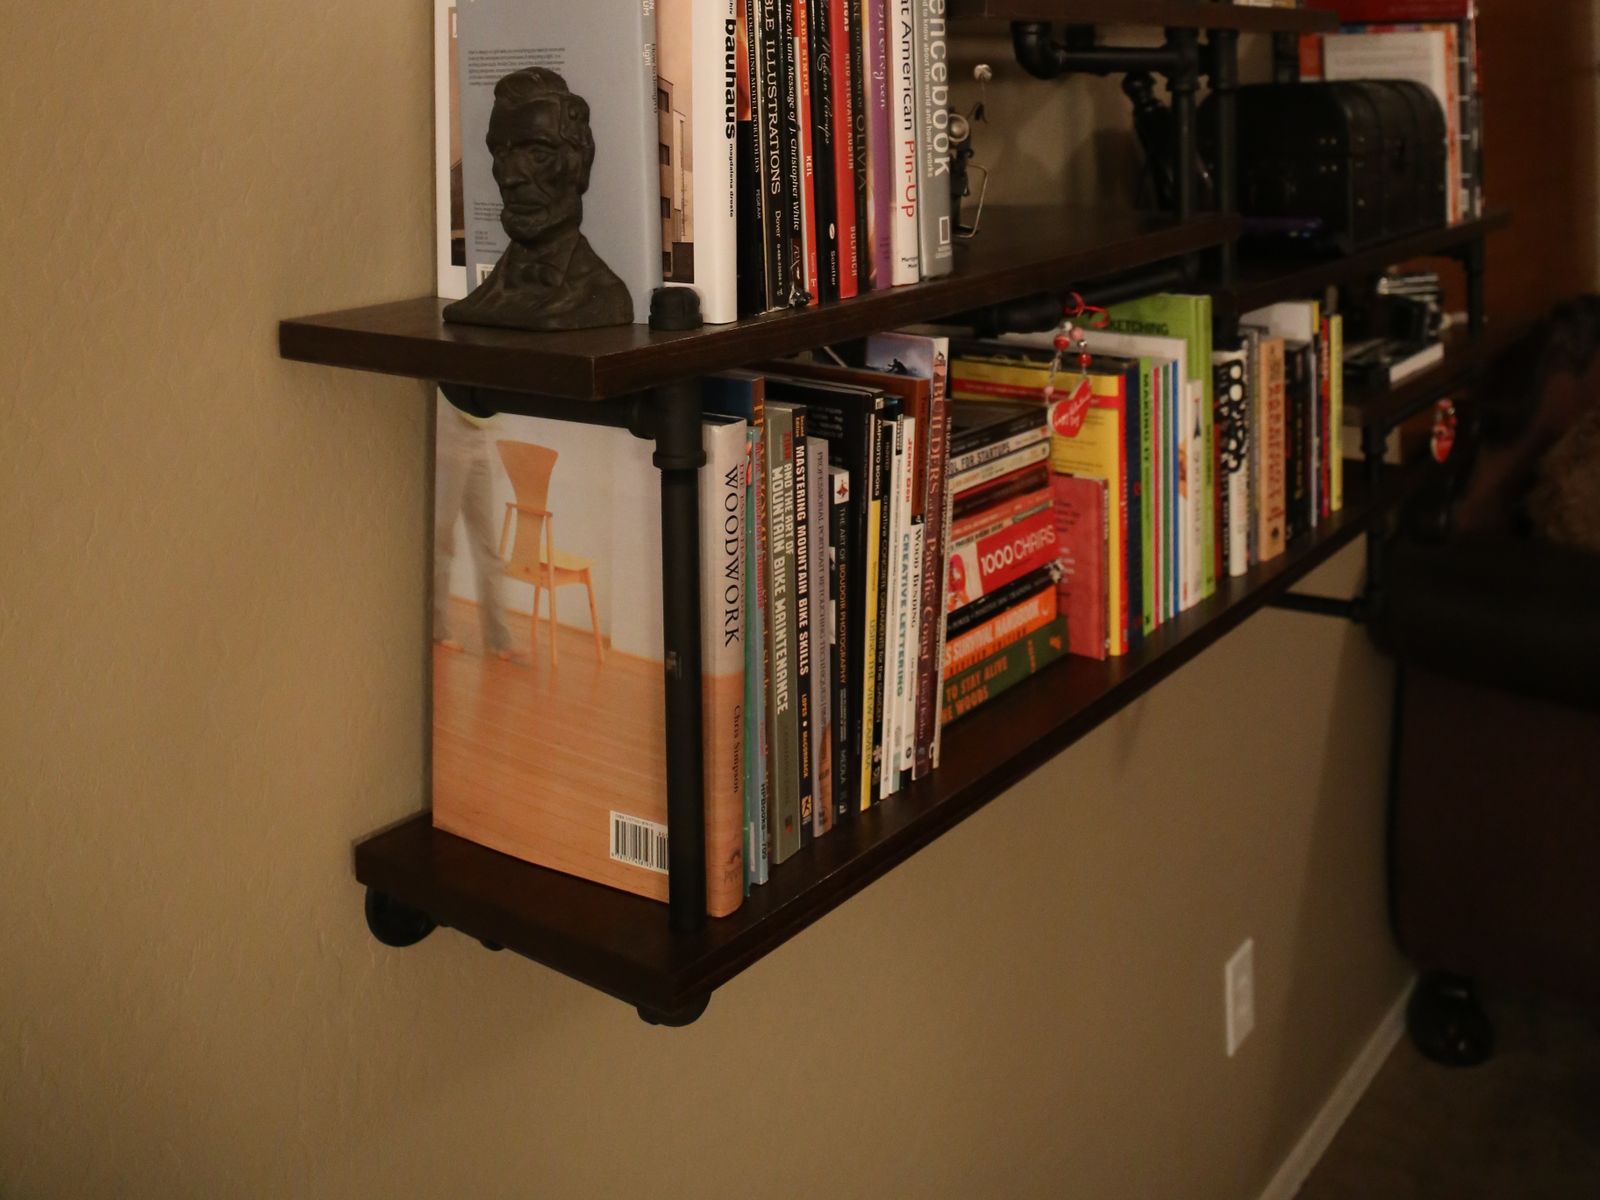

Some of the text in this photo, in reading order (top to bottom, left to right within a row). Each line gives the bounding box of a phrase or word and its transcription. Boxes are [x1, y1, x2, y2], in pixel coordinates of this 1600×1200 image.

[785, 2, 794, 23] The
[785, 24, 795, 42] Art
[799, 8, 807, 44] MADE
[921, 8, 930, 18] to
[921, 18, 930, 41] know
[642, 44, 652, 66] Light
[786, 42, 796, 63] and
[800, 48, 809, 97] SIMPLE
[901, 20, 915, 131] American
[922, 42, 931, 67] about
[922, 68, 931, 83] the
[725, 18, 737, 140] bauhaus
[787, 65, 798, 109] Message
[923, 83, 932, 107] world
[765, 40, 781, 195] ILLUSTRATIONS
[788, 110, 798, 122] of
[789, 127, 798, 135] J.
[923, 108, 932, 124] and
[924, 126, 932, 142] how
[789, 138, 801, 201] Christopher
[855, 113, 866, 192] OLIVIA
[924, 143, 932, 151] it
[925, 152, 933, 178] works
[902, 139, 918, 218] Pin-Up
[774, 210, 782, 238] Dover
[792, 201, 802, 232] White
[874, 418, 883, 496] AMPHOTO BOOKS
[929, 381, 945, 495] BUILDERS
[772, 466, 786, 554] MOUNTAIN
[784, 463, 794, 556] AND THE ART OF
[817, 451, 825, 525] PROFESSIONAL
[724, 464, 738, 648] WOODWORK
[795, 444, 809, 676] MASTERING MOUNTAIN BIKE SKILLS
[839, 552, 846, 562] OF
[924, 537, 937, 601] Pacific
[982, 546, 1013, 576] 1000
[1014, 525, 1056, 560] CHAIRS
[773, 557, 787, 594] BIKE
[911, 528, 922, 628] WOOD BENDING
[774, 597, 789, 716] MAINTENANCE
[839, 610, 847, 685] PHOTOGRAPHY
[920, 606, 934, 662] Coast
[732, 704, 742, 794] Chris Simpson
